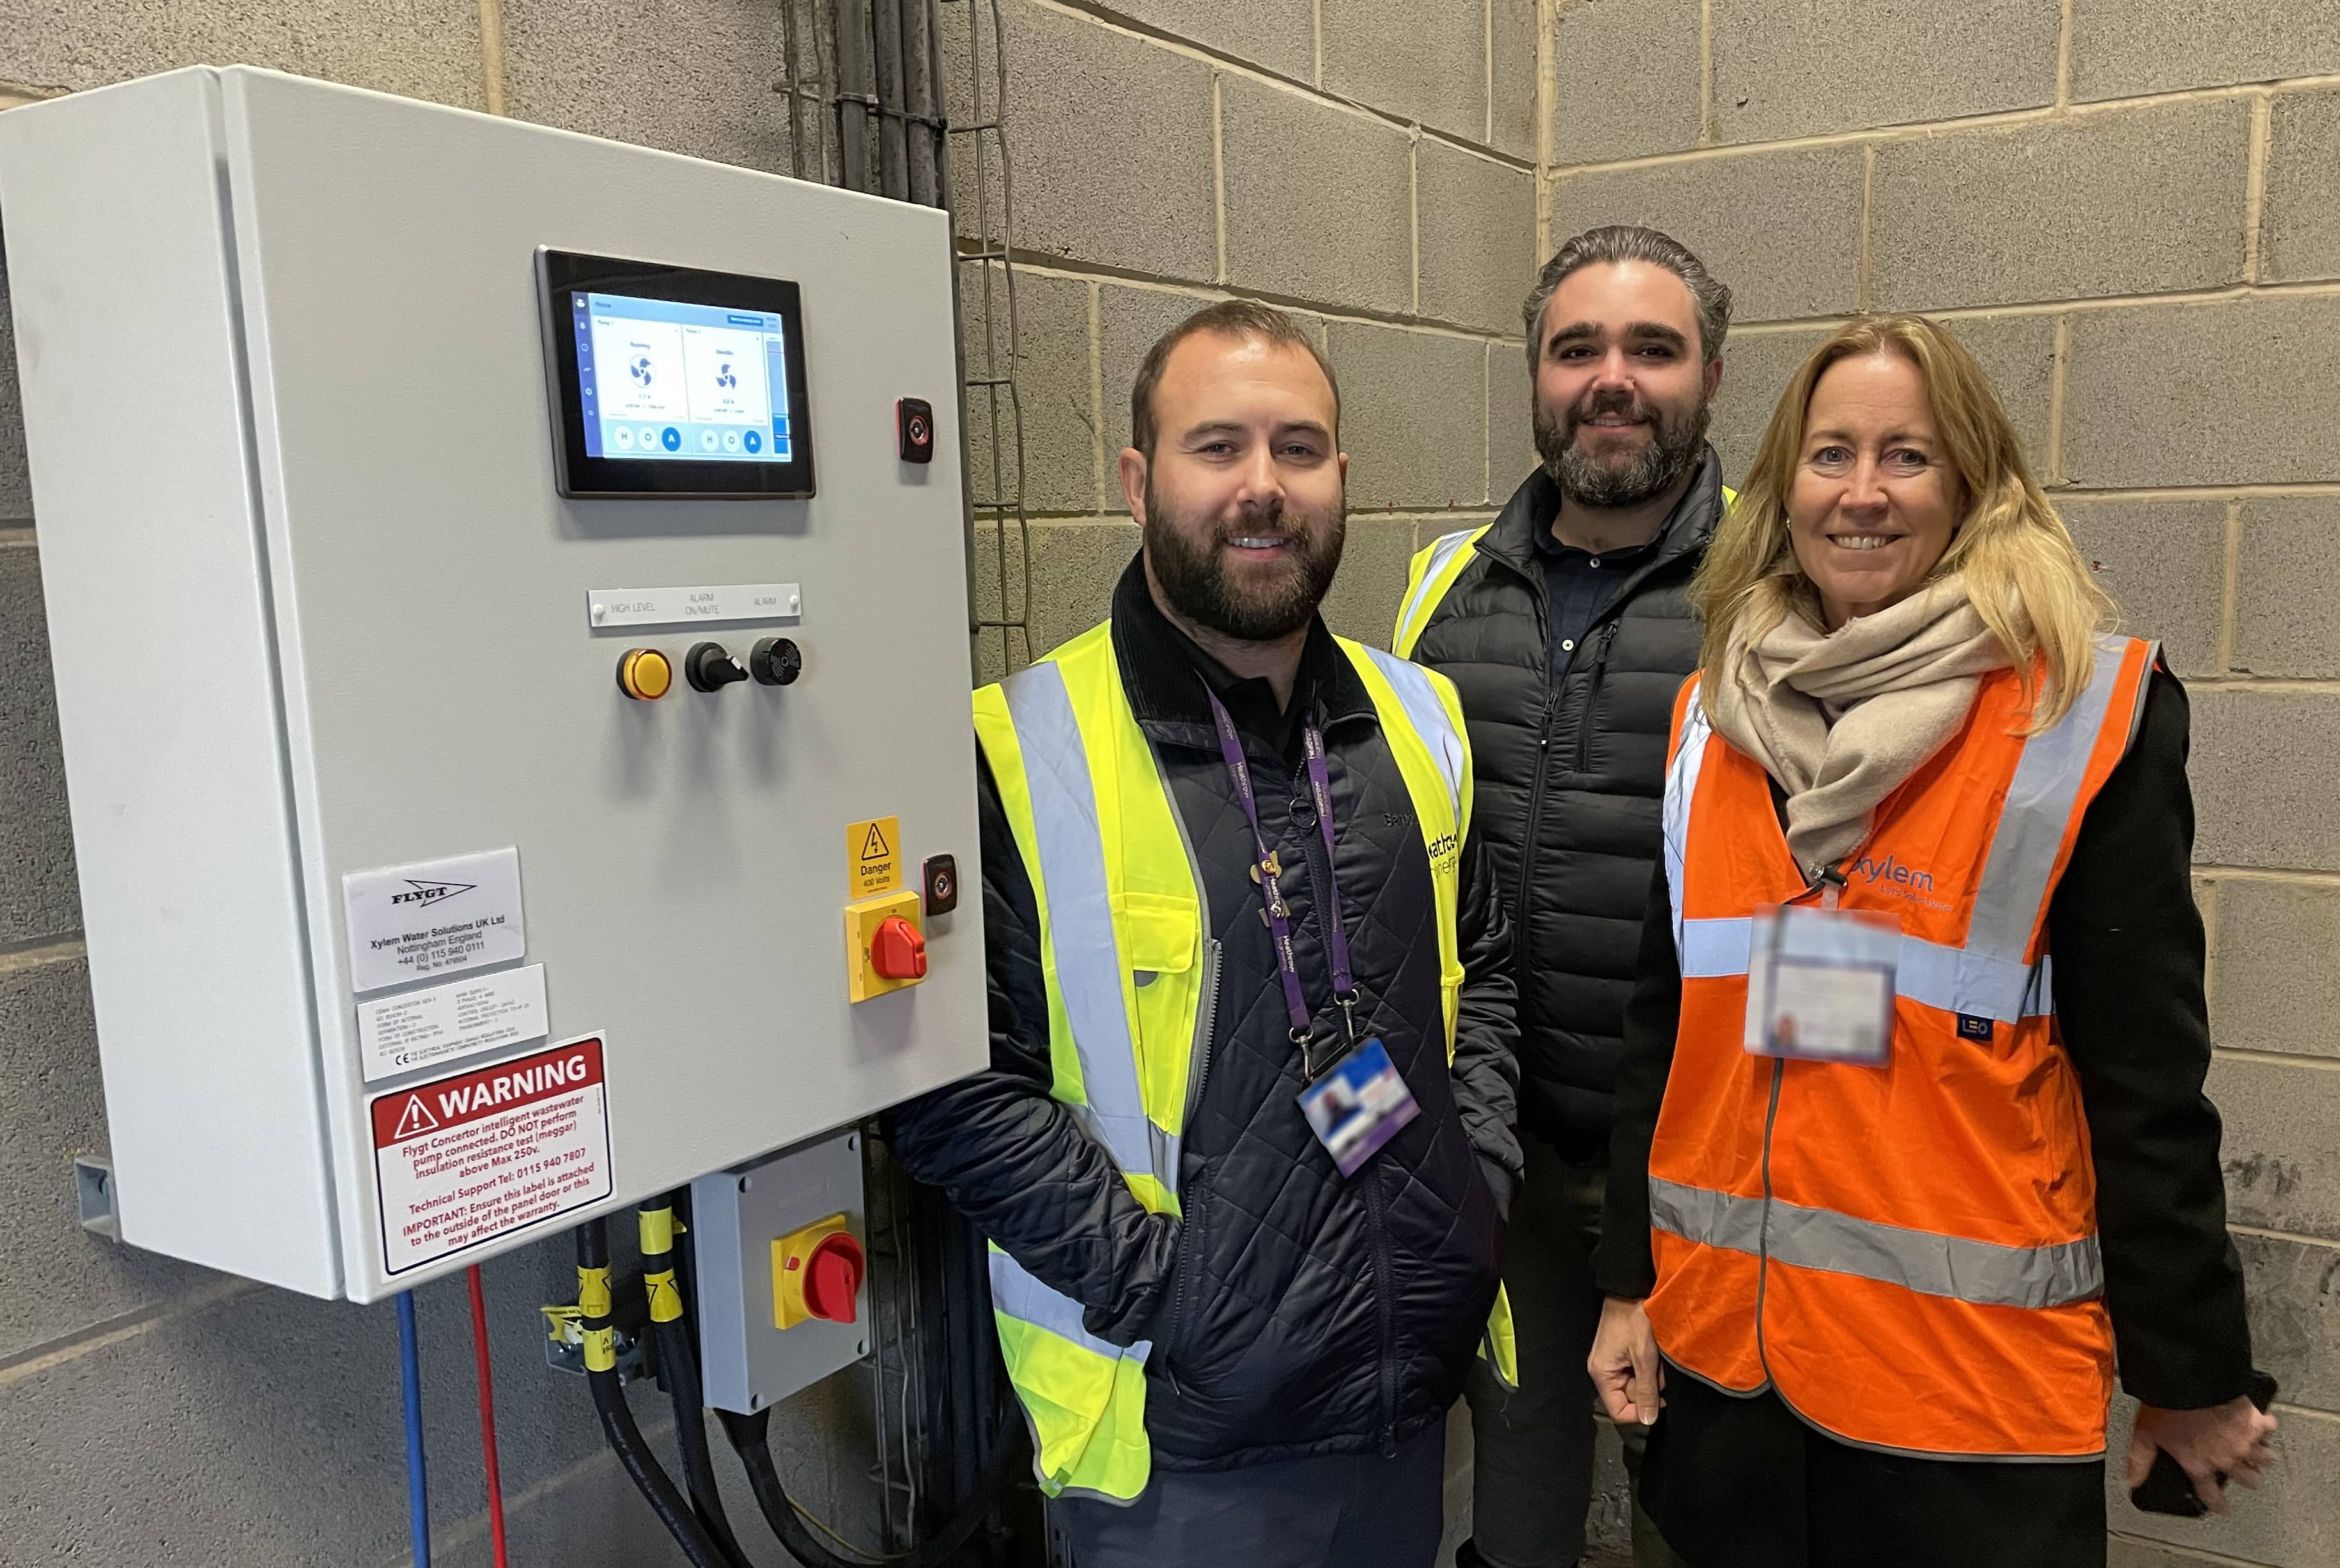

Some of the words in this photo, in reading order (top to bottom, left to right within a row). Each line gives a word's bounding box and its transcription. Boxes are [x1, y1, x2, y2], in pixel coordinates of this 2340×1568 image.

[668, 433, 675, 442] A
[750, 437, 756, 445] A
[612, 603, 630, 612] HIGH
[633, 602, 655, 612] LEVEL
[685, 605, 721, 615] ON/MUTE
[690, 593, 714, 603] ALARM
[754, 597, 776, 607] ALARM
[1305, 727, 1315, 759] Heathrow
[1236, 761, 1249, 798] Heathrow
[861, 862, 891, 876] Danger
[864, 878, 874, 887] 400
[876, 876, 890, 885] Volts
[1852, 854, 1933, 892] xylem
[391, 887, 447, 904] FLYGT
[370, 938, 400, 950] Xylem
[401, 932, 430, 943] Water
[431, 923, 474, 937] Solutions
[476, 918, 490, 928] UK
[491, 914, 505, 925] Ltd
[397, 939, 446, 954] Nottingham
[448, 930, 483, 945] England
[398, 956, 414, 965] +44
[416, 952, 429, 964] (0)
[431, 948, 446, 959] 115
[448, 945, 464, 956] 940
[465, 940, 484, 952] 0111
[1283, 935, 1294, 973] Heathrow
[396, 1053, 409, 1066] CE
[438, 1055, 586, 1118] WARNING
[403, 1143, 429, 1158] Flygt
[431, 1128, 480, 1148] Concertor
[483, 1112, 530, 1133] intelligent
[532, 1096, 584, 1117] wastewater
[414, 1153, 442, 1170] pump
[446, 1133, 498, 1157] connected.
[500, 1127, 516, 1140] DO
[518, 1120, 538, 1134] NOT
[541, 1110, 577, 1129] perform
[415, 1158, 464, 1179] insulation
[467, 1142, 514, 1163] resistance
[516, 1135, 533, 1147] test
[536, 1120, 577, 1142] (meggar)
[460, 1163, 489, 1177] above
[492, 1155, 511, 1167] Max
[515, 1146, 540, 1160] 250v.
[409, 1190, 455, 1215] Technical
[458, 1179, 497, 1197] Support
[498, 1172, 515, 1184] Tel:
[517, 1163, 541, 1178] 0115
[543, 1156, 561, 1170] 940
[563, 1147, 586, 1163] 7807
[403, 1207, 467, 1236] IMPORTANT:
[470, 1197, 502, 1213] Ensure
[504, 1188, 521, 1201] this
[523, 1178, 546, 1195] label
[547, 1177, 555, 1186] is
[557, 1161, 594, 1183] attached
[411, 1237, 422, 1246] to
[424, 1230, 440, 1241] the
[443, 1216, 479, 1235] outside
[481, 1209, 492, 1222] of
[494, 1206, 509, 1217] the
[511, 1193, 537, 1214] panel
[539, 1188, 561, 1202] door
[562, 1184, 572, 1193] or
[574, 1176, 590, 1189] this
[448, 1232, 469, 1246] may
[471, 1221, 498, 1238] affect
[500, 1216, 515, 1227] the
[518, 1200, 560, 1221] warranty.
